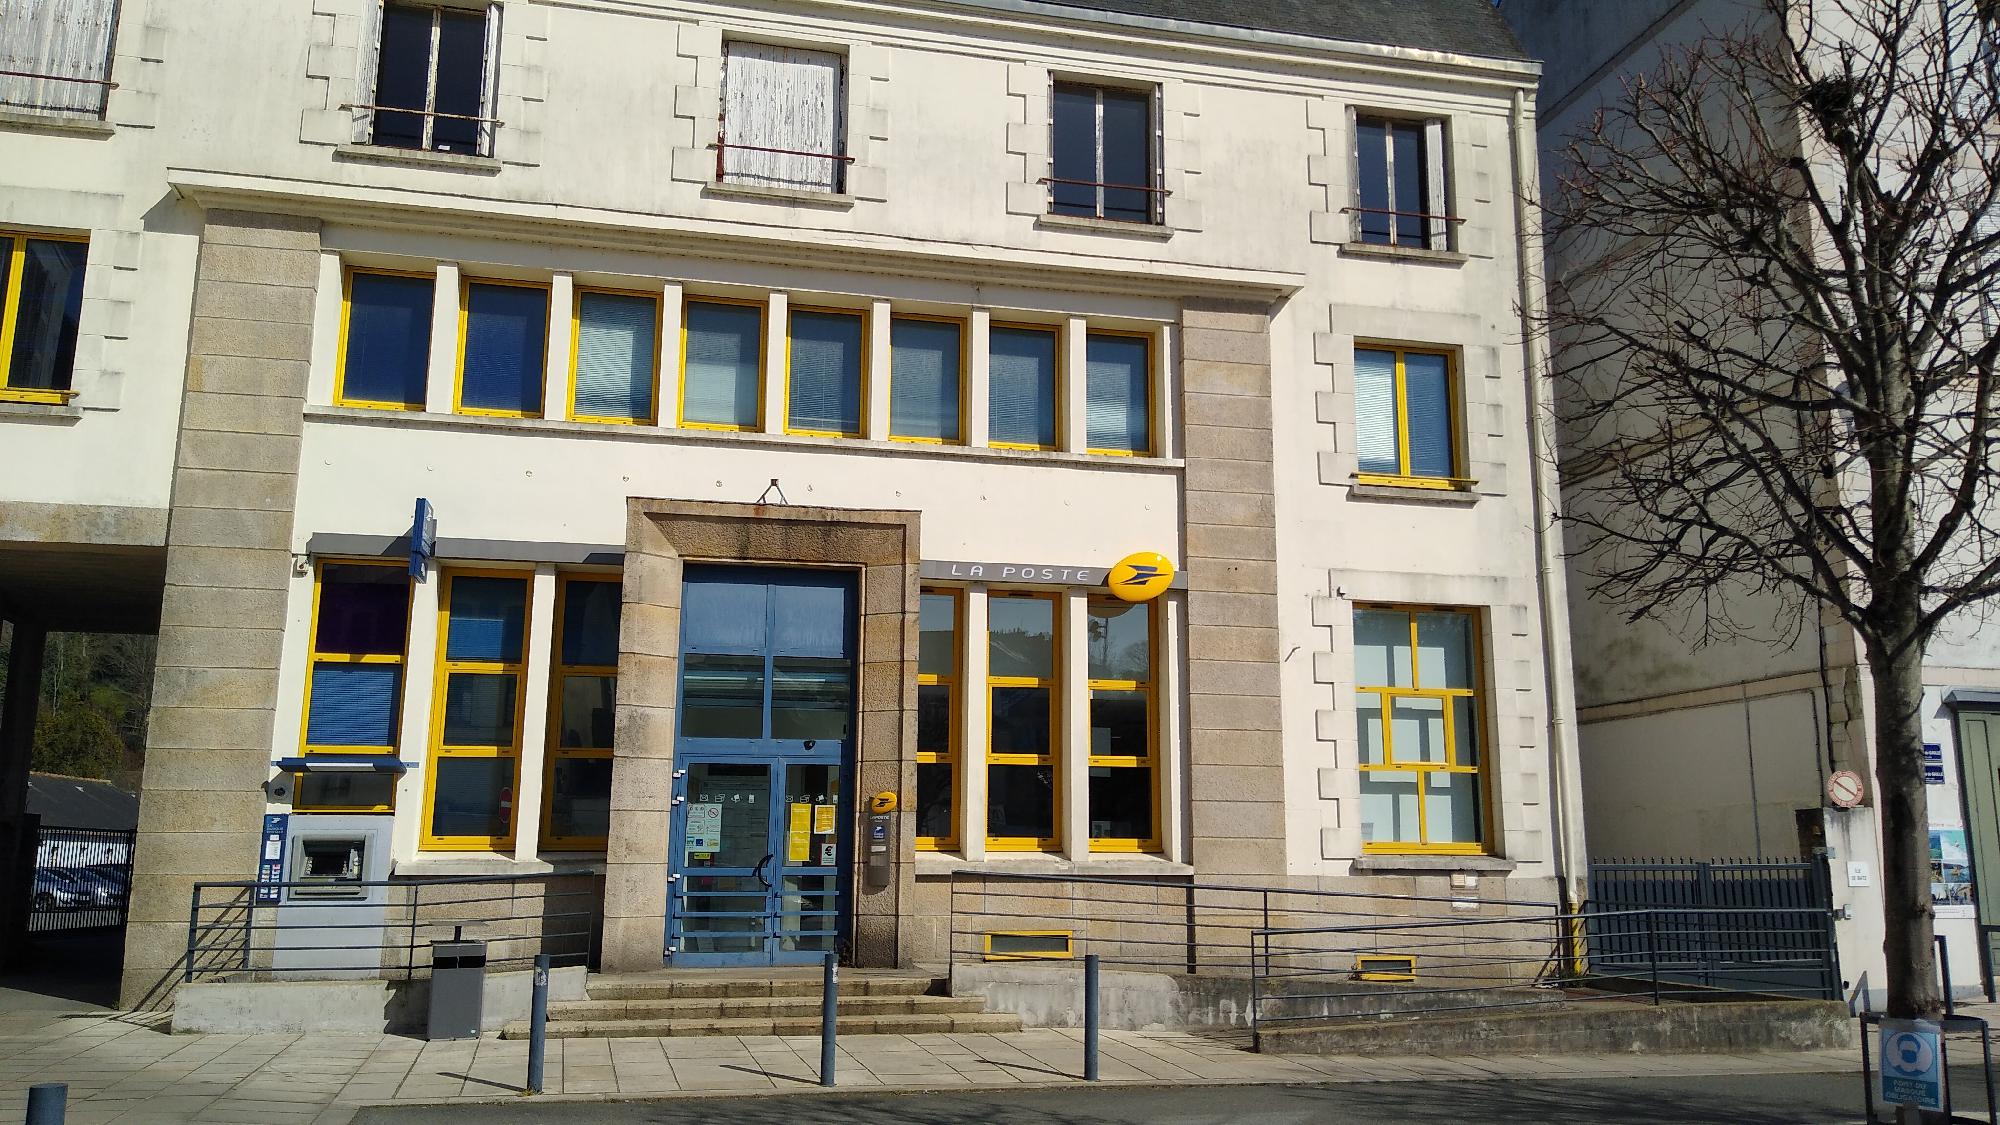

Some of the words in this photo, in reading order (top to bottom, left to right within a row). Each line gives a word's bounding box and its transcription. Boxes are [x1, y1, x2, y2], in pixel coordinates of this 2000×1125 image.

[951, 564, 984, 577] LA
[1002, 566, 1090, 581] POSTE
[1893, 1080, 1913, 1088] PORT
[1915, 1082, 1927, 1090] DU
[1894, 1086, 1926, 1097] MASQUE
[1885, 1091, 1936, 1105] OBLIGATOIRE
